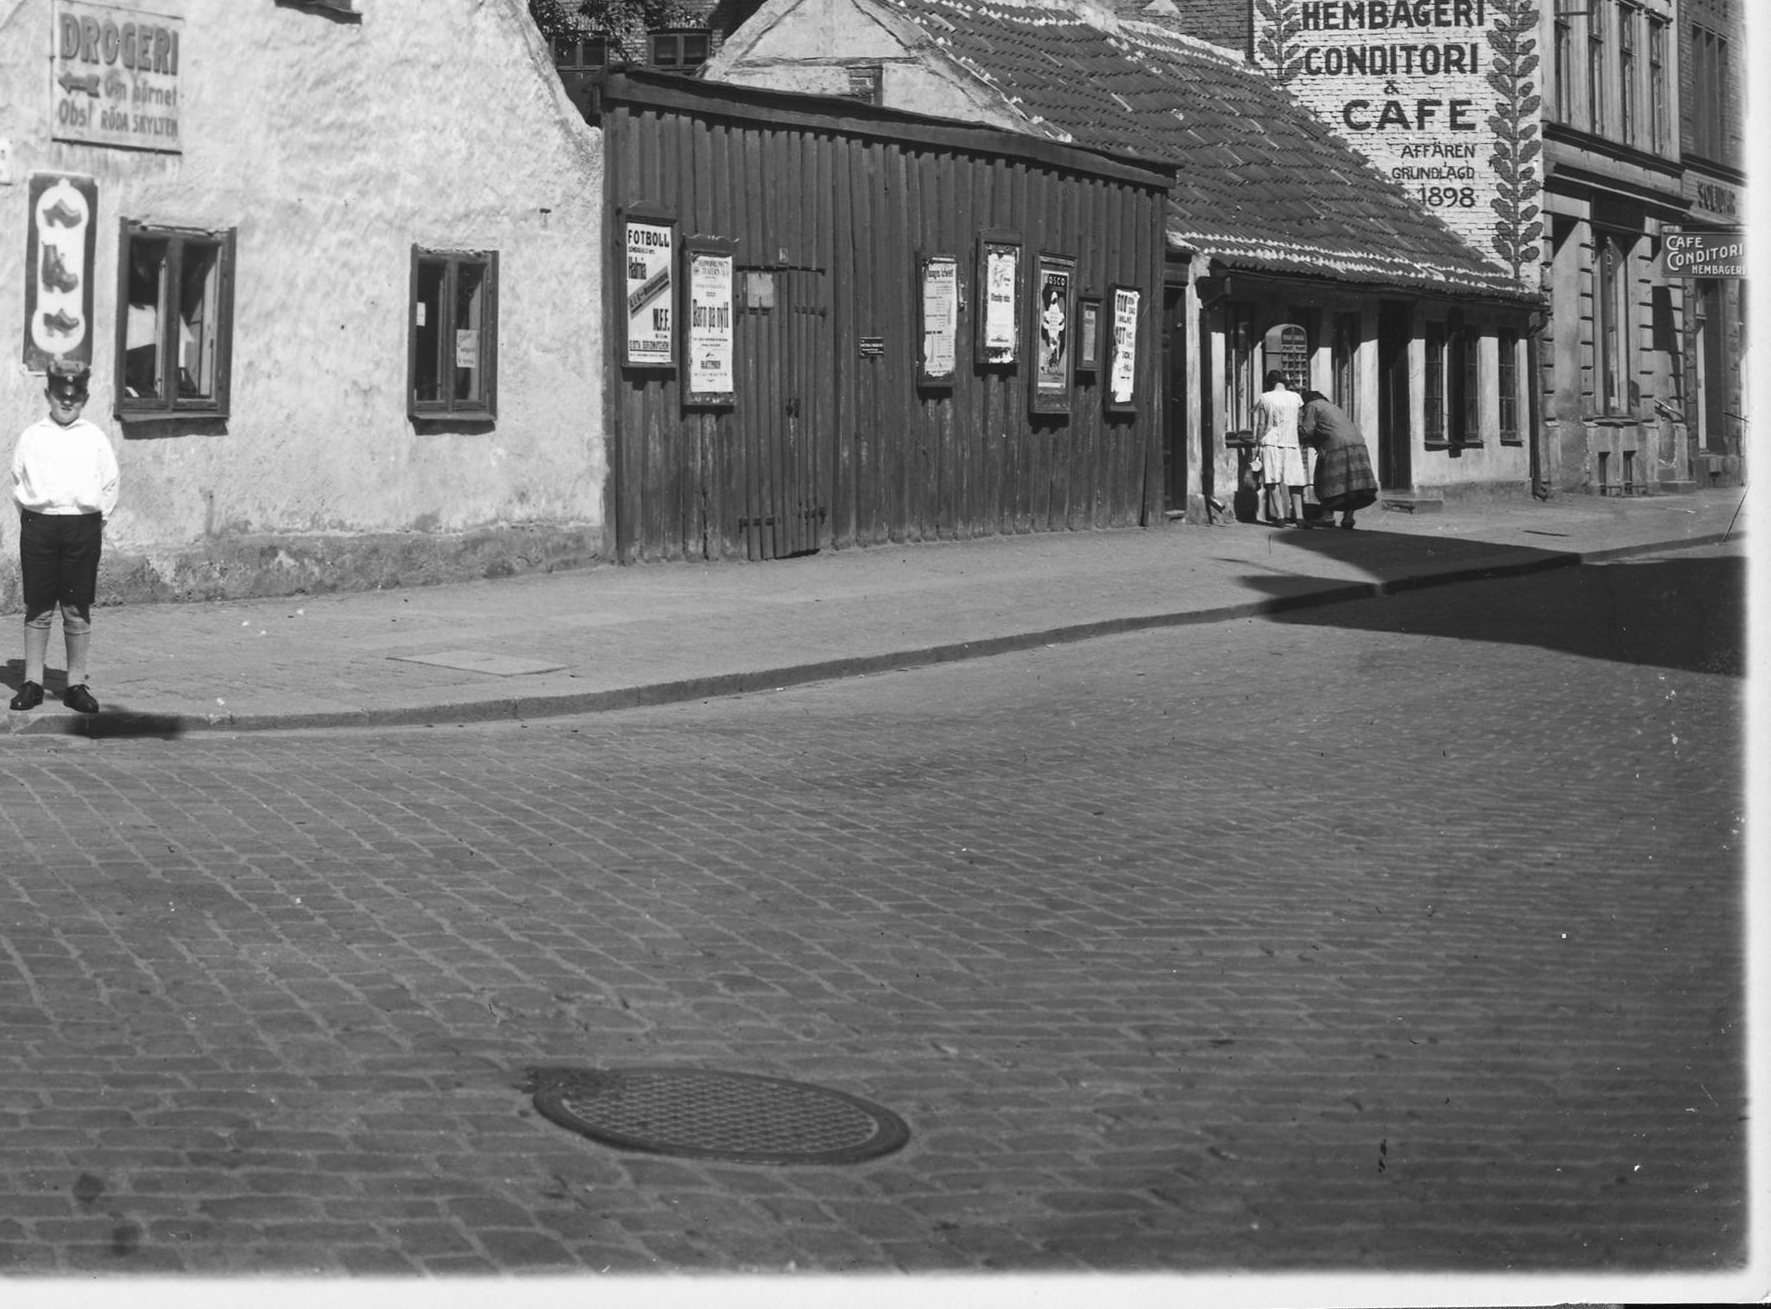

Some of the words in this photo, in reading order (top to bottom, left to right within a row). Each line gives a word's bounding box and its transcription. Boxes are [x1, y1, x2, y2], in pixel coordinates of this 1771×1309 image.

[59, 12, 179, 76] DROGERI
[1305, 43, 1478, 76] CONDITORI
[59, 98, 92, 129] Obs!
[101, 106, 128, 132] RÖDA
[132, 114, 178, 138] SKYLTEN
[1343, 100, 1476, 131] CAFE
[1401, 142, 1475, 158] AFFÄREN
[1420, 186, 1475, 208] 1898
[628, 229, 670, 248] FOTBOLL
[1668, 243, 1743, 271] CONDITORI
